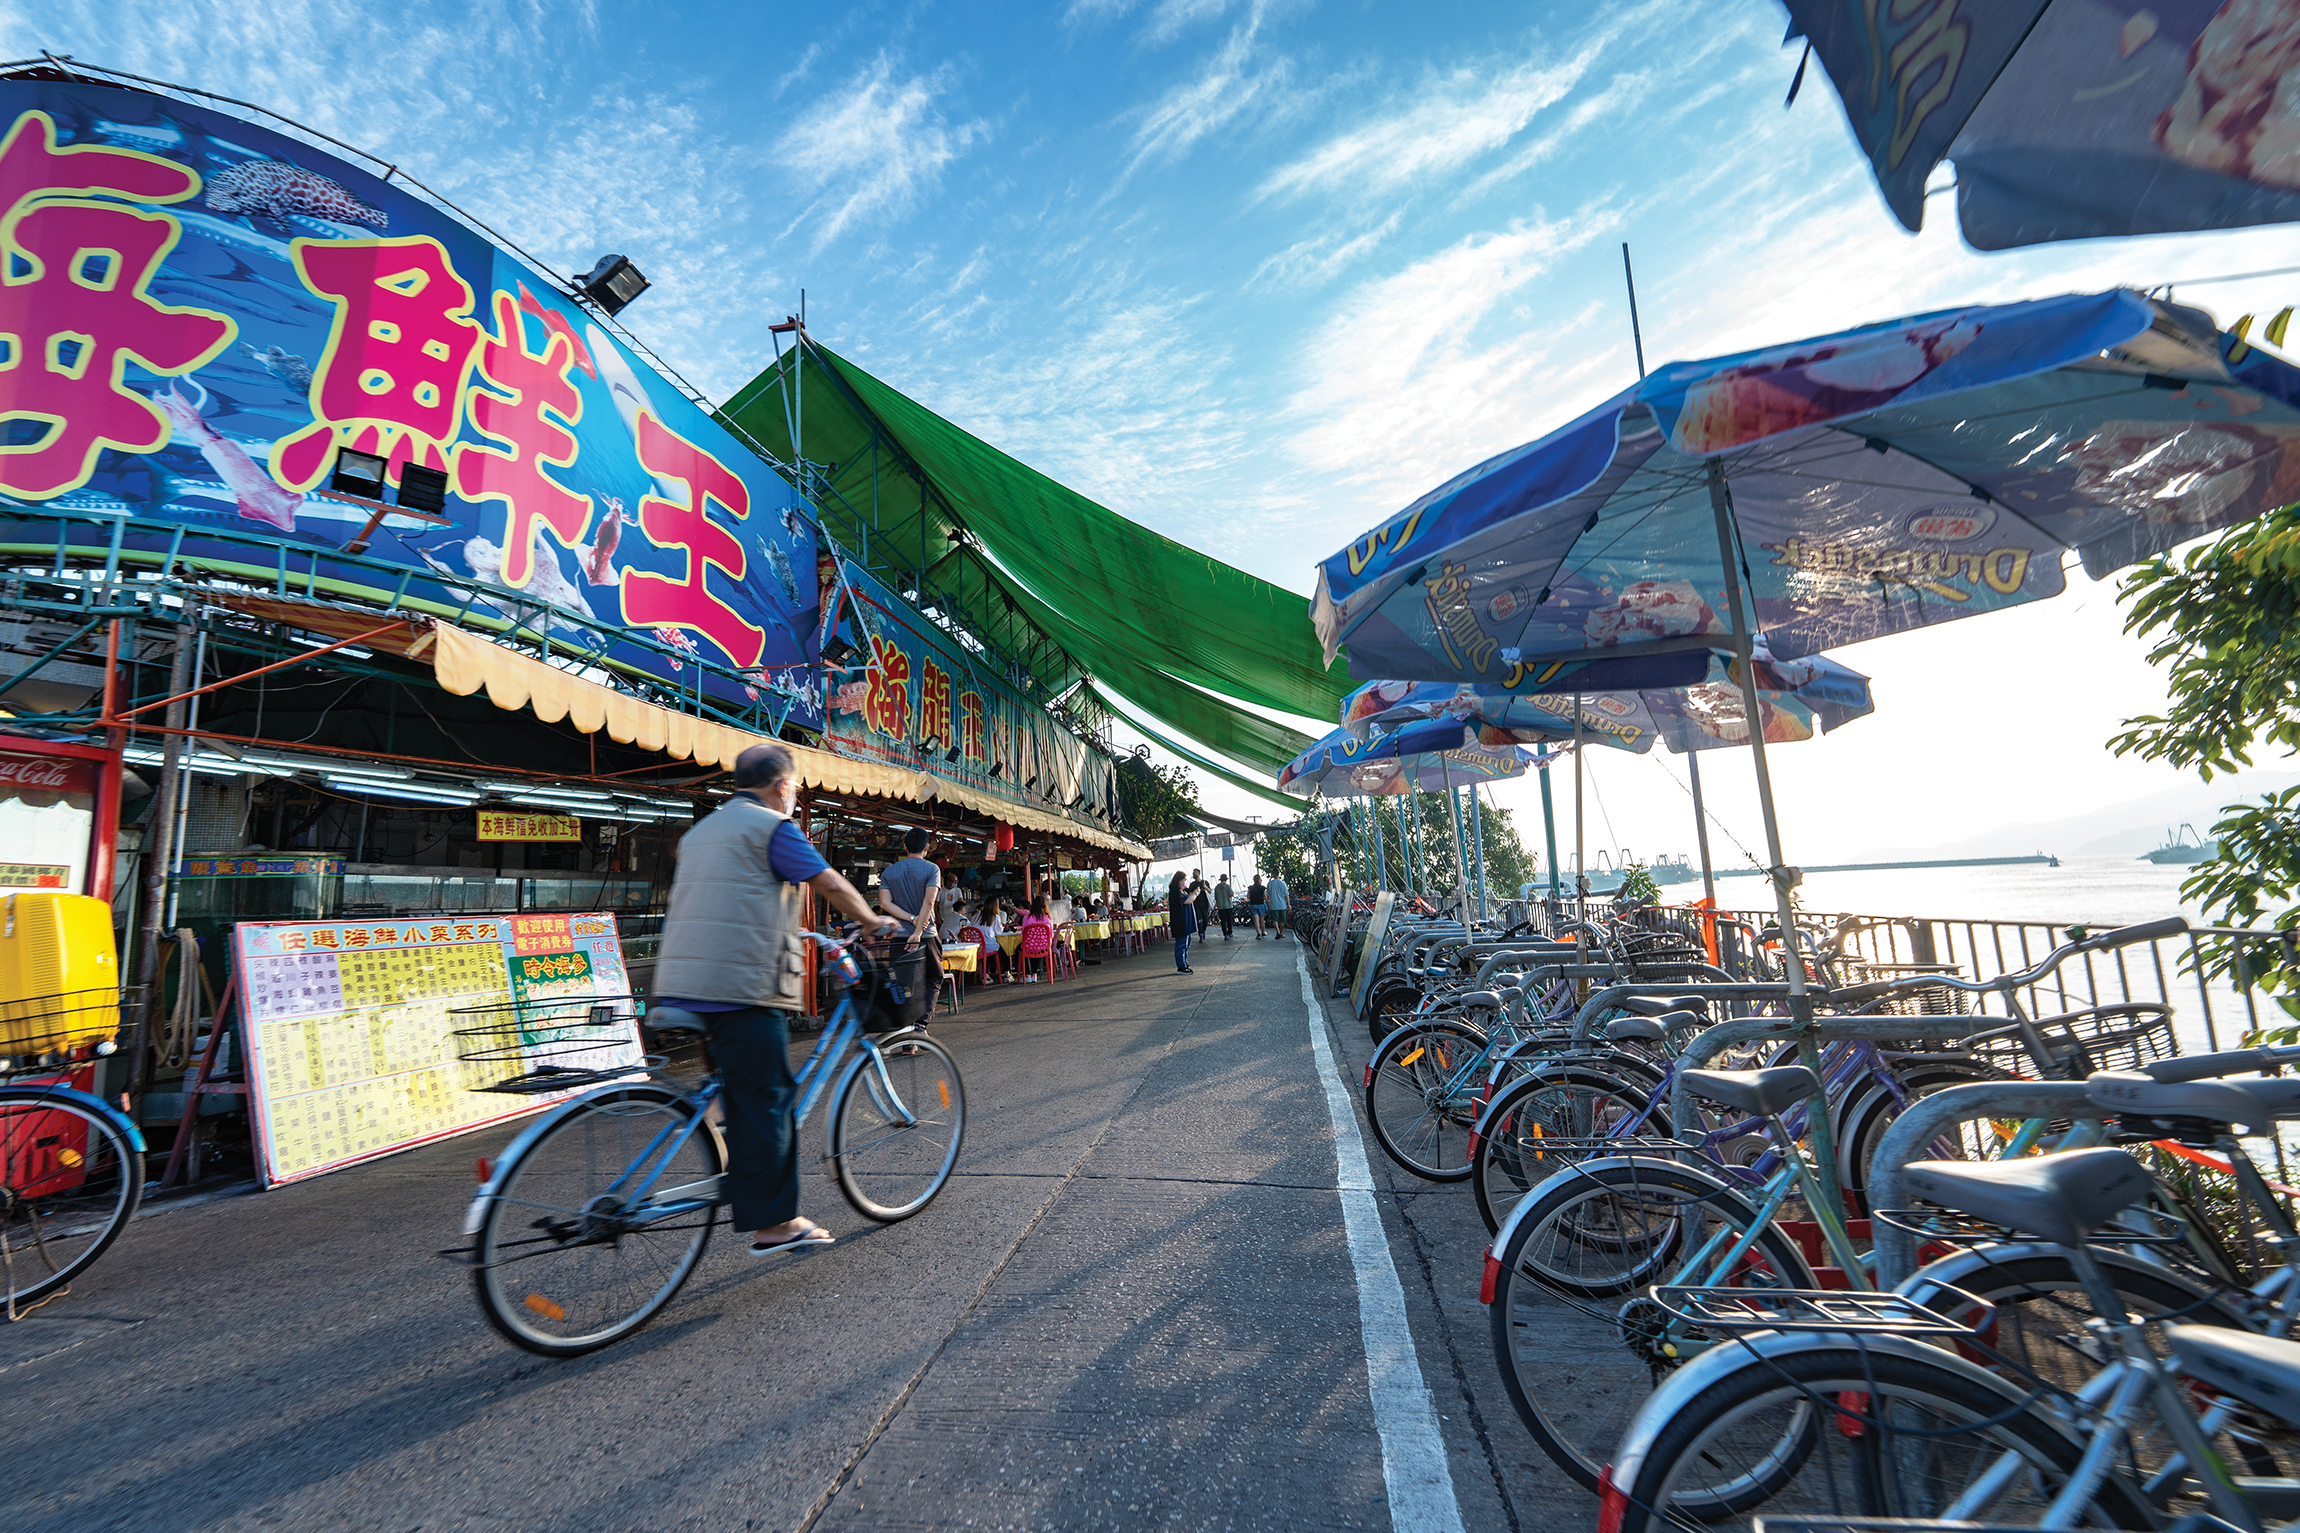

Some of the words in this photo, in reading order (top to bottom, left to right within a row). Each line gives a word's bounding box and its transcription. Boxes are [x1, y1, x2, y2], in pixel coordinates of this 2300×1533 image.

[276, 921, 499, 952] 任選海鮮小菜系列
[516, 918, 566, 935] 歡迎使用
[516, 934, 572, 951] 電子消費券
[523, 953, 588, 979] 時令海參
